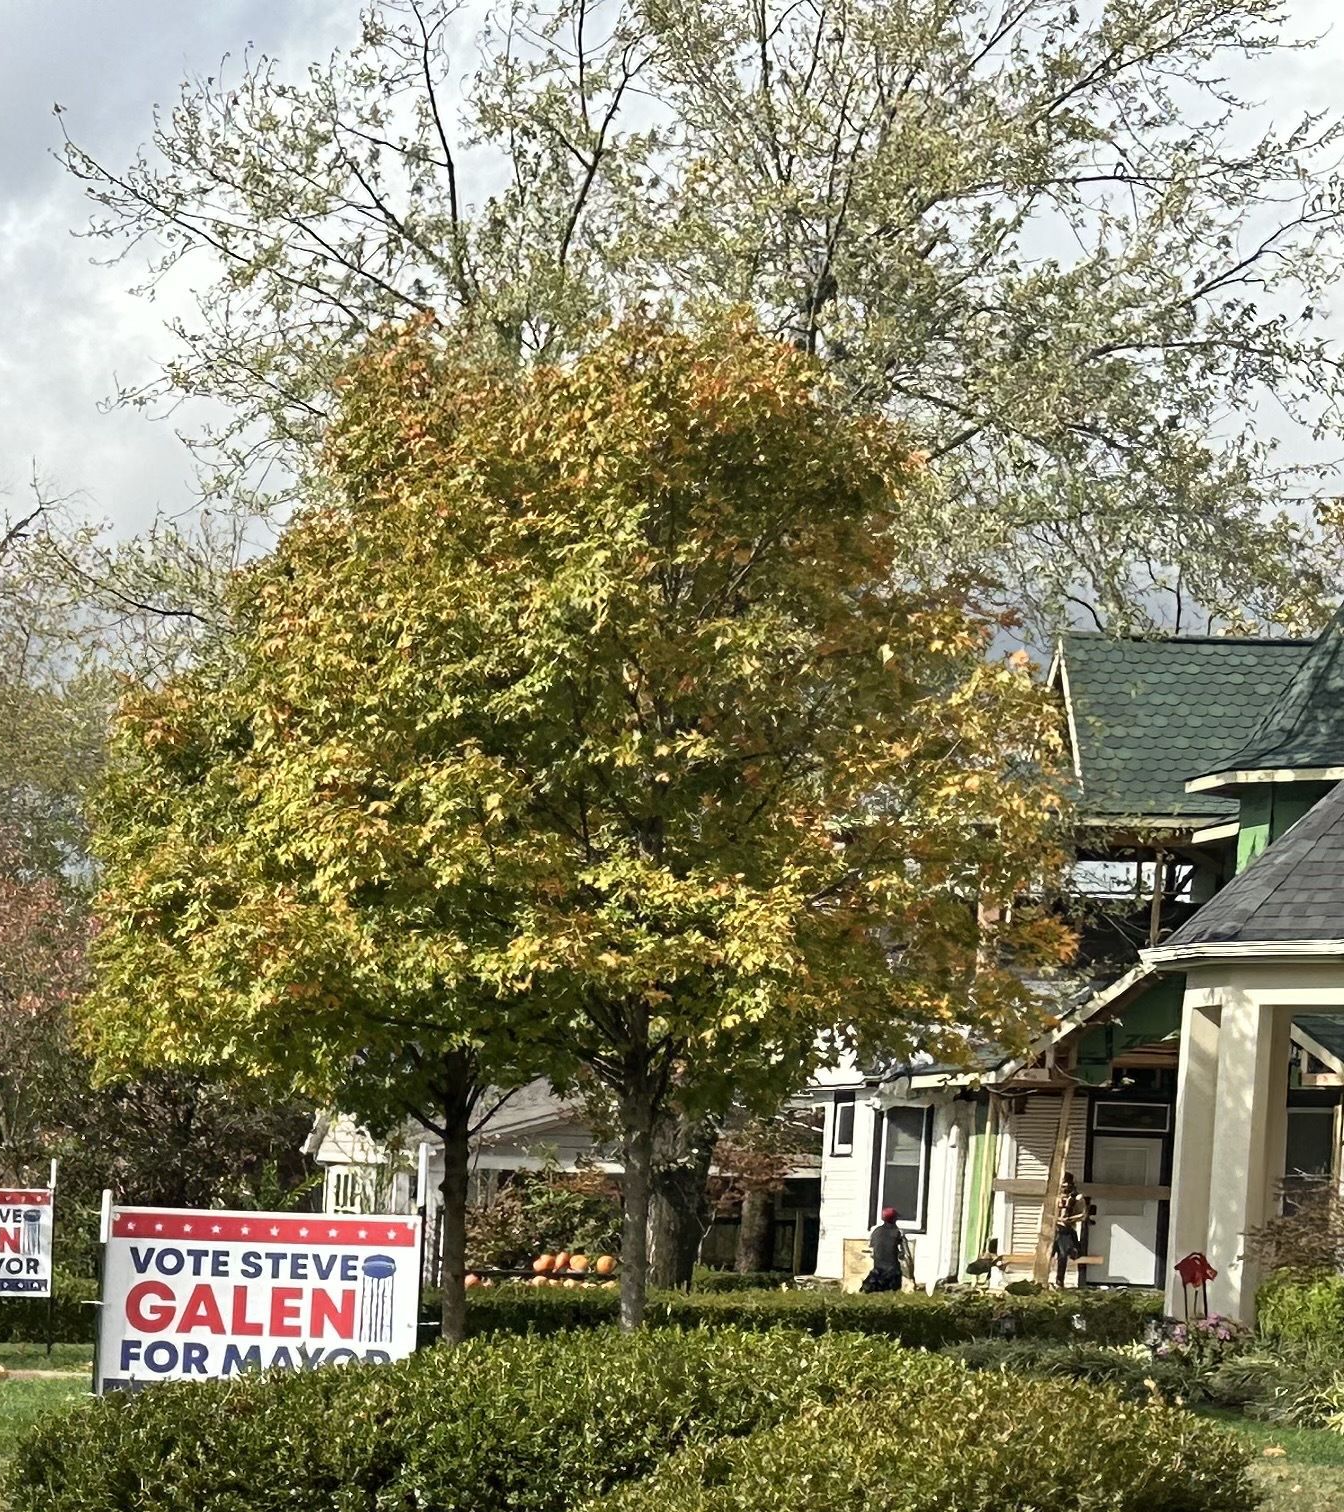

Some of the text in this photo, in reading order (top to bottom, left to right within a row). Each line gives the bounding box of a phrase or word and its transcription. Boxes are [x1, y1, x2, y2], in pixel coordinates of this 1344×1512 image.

[129, 1246, 359, 1281] VOTE STEVE
[125, 1280, 357, 1339] GALEN
[119, 1339, 210, 1374] FOR
